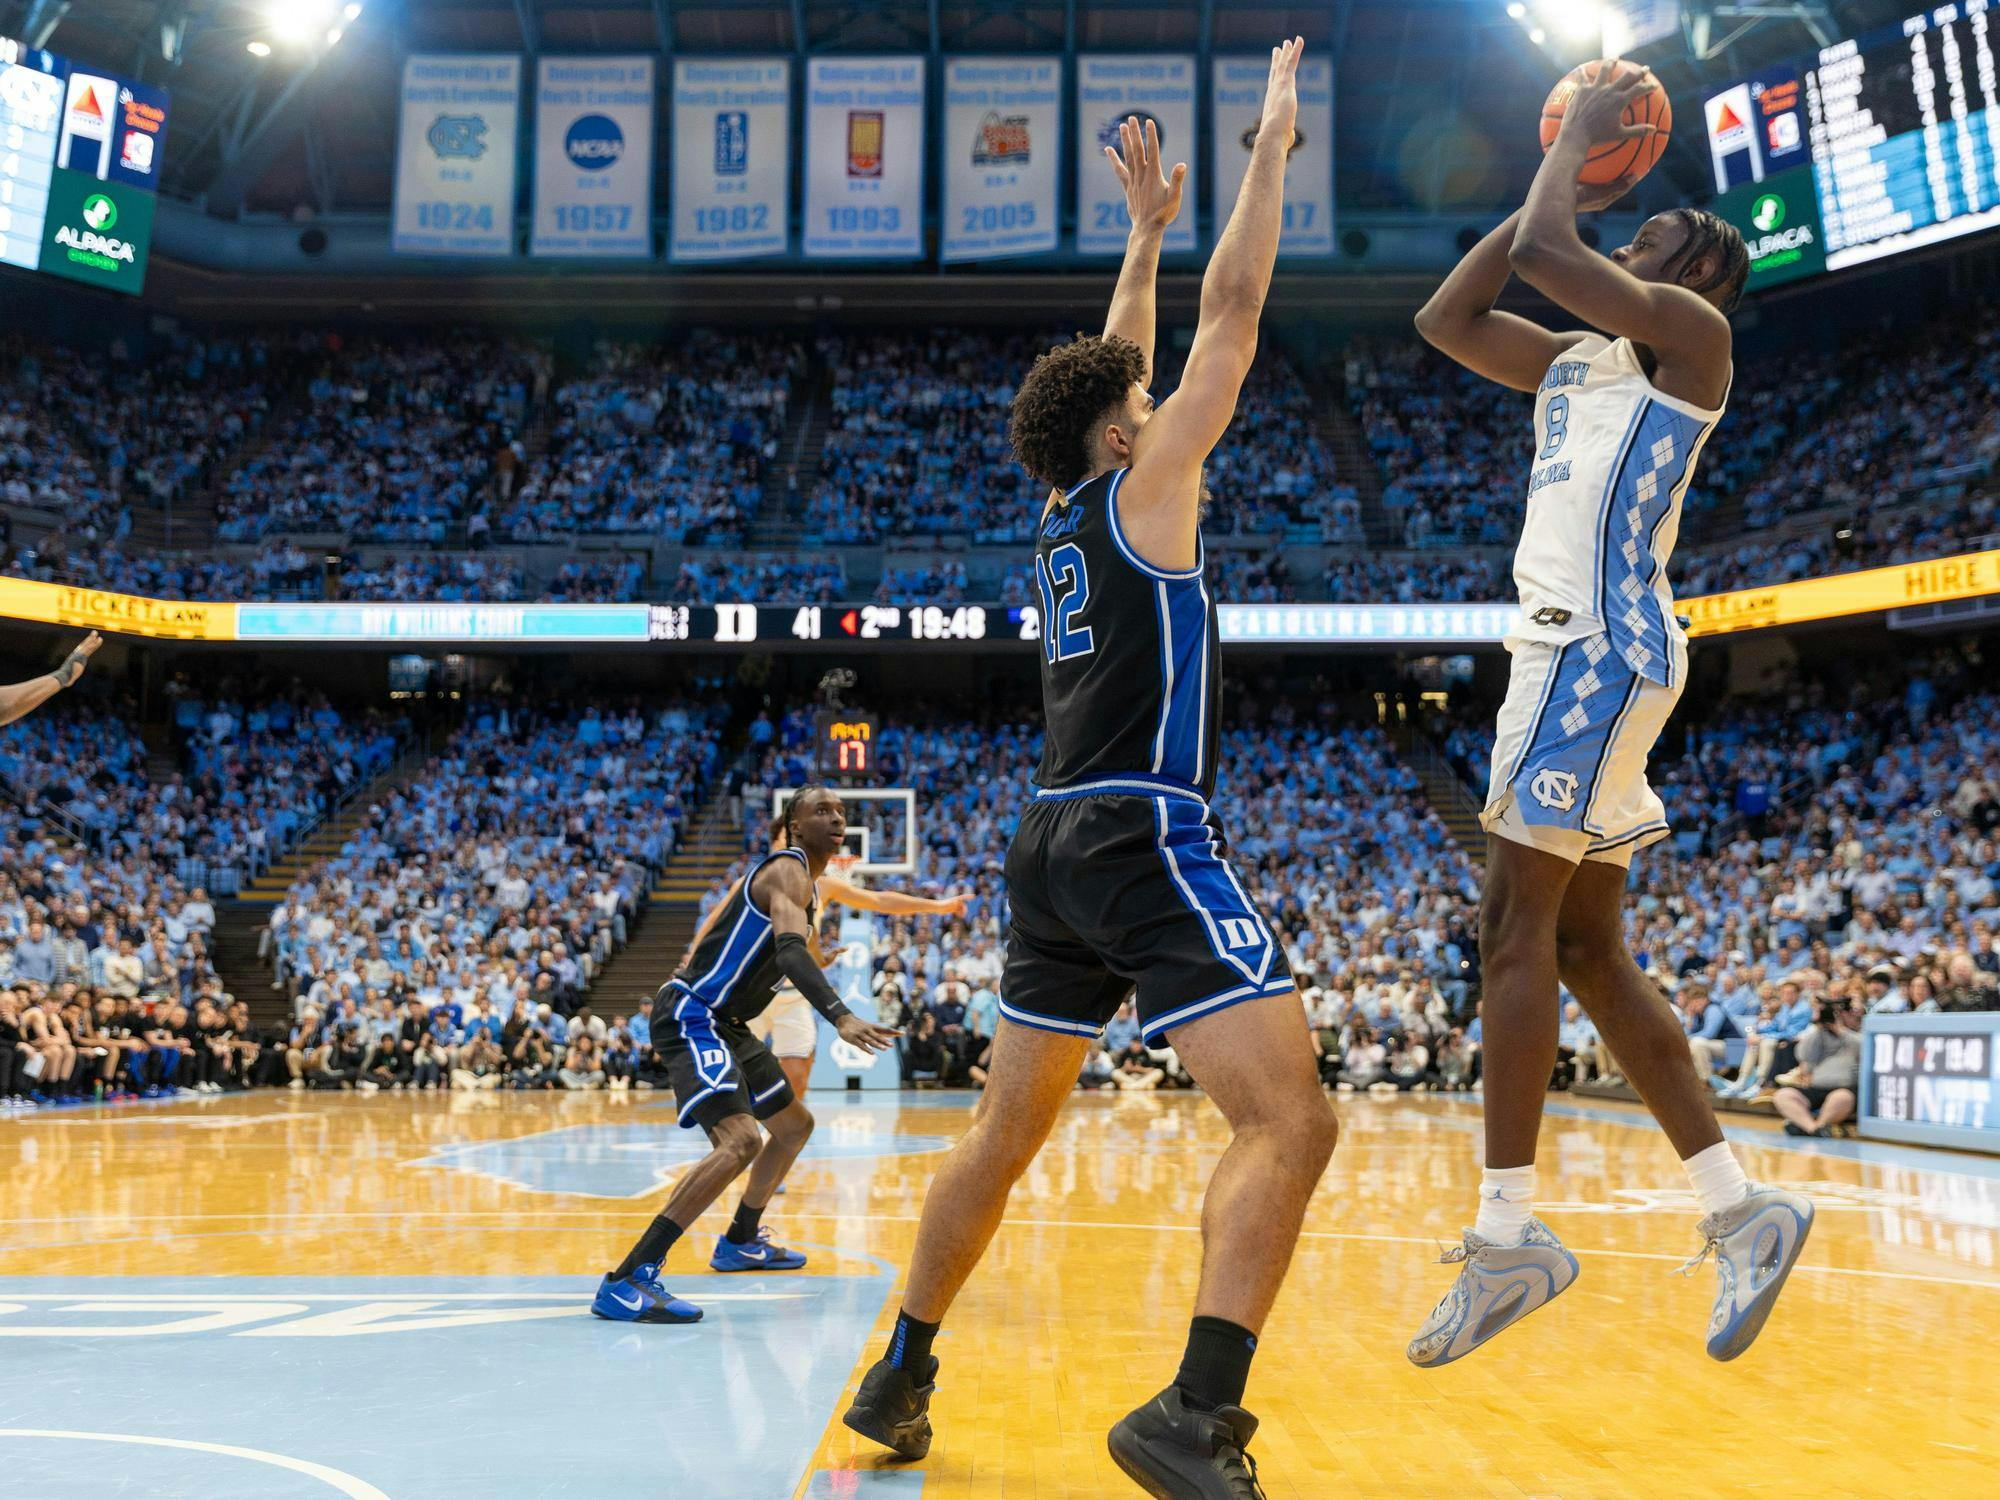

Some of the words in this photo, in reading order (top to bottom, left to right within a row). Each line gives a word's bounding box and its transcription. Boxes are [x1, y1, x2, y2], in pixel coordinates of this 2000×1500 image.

[568, 140, 623, 157] NCAA
[417, 203, 494, 230] 1924
[555, 205, 632, 231] 1957
[695, 204, 768, 232] 1982
[827, 206, 900, 232] 1993
[962, 203, 1036, 233] 2005
[1095, 203, 1132, 227] 20
[1283, 203, 1317, 228] 17
[55, 225, 135, 264] ALPACA
[1749, 224, 1814, 261] LPACA
[1539, 393, 1570, 460] 8
[1904, 561, 1982, 599] HIRE
[1036, 541, 1095, 665] 12
[714, 604, 758, 641] D
[792, 606, 821, 640] 41
[1019, 606, 1040, 640] 2
[1227, 610, 1374, 635] CAROLINA
[839, 740, 866, 770] 17
[1217, 917, 1262, 949] D
